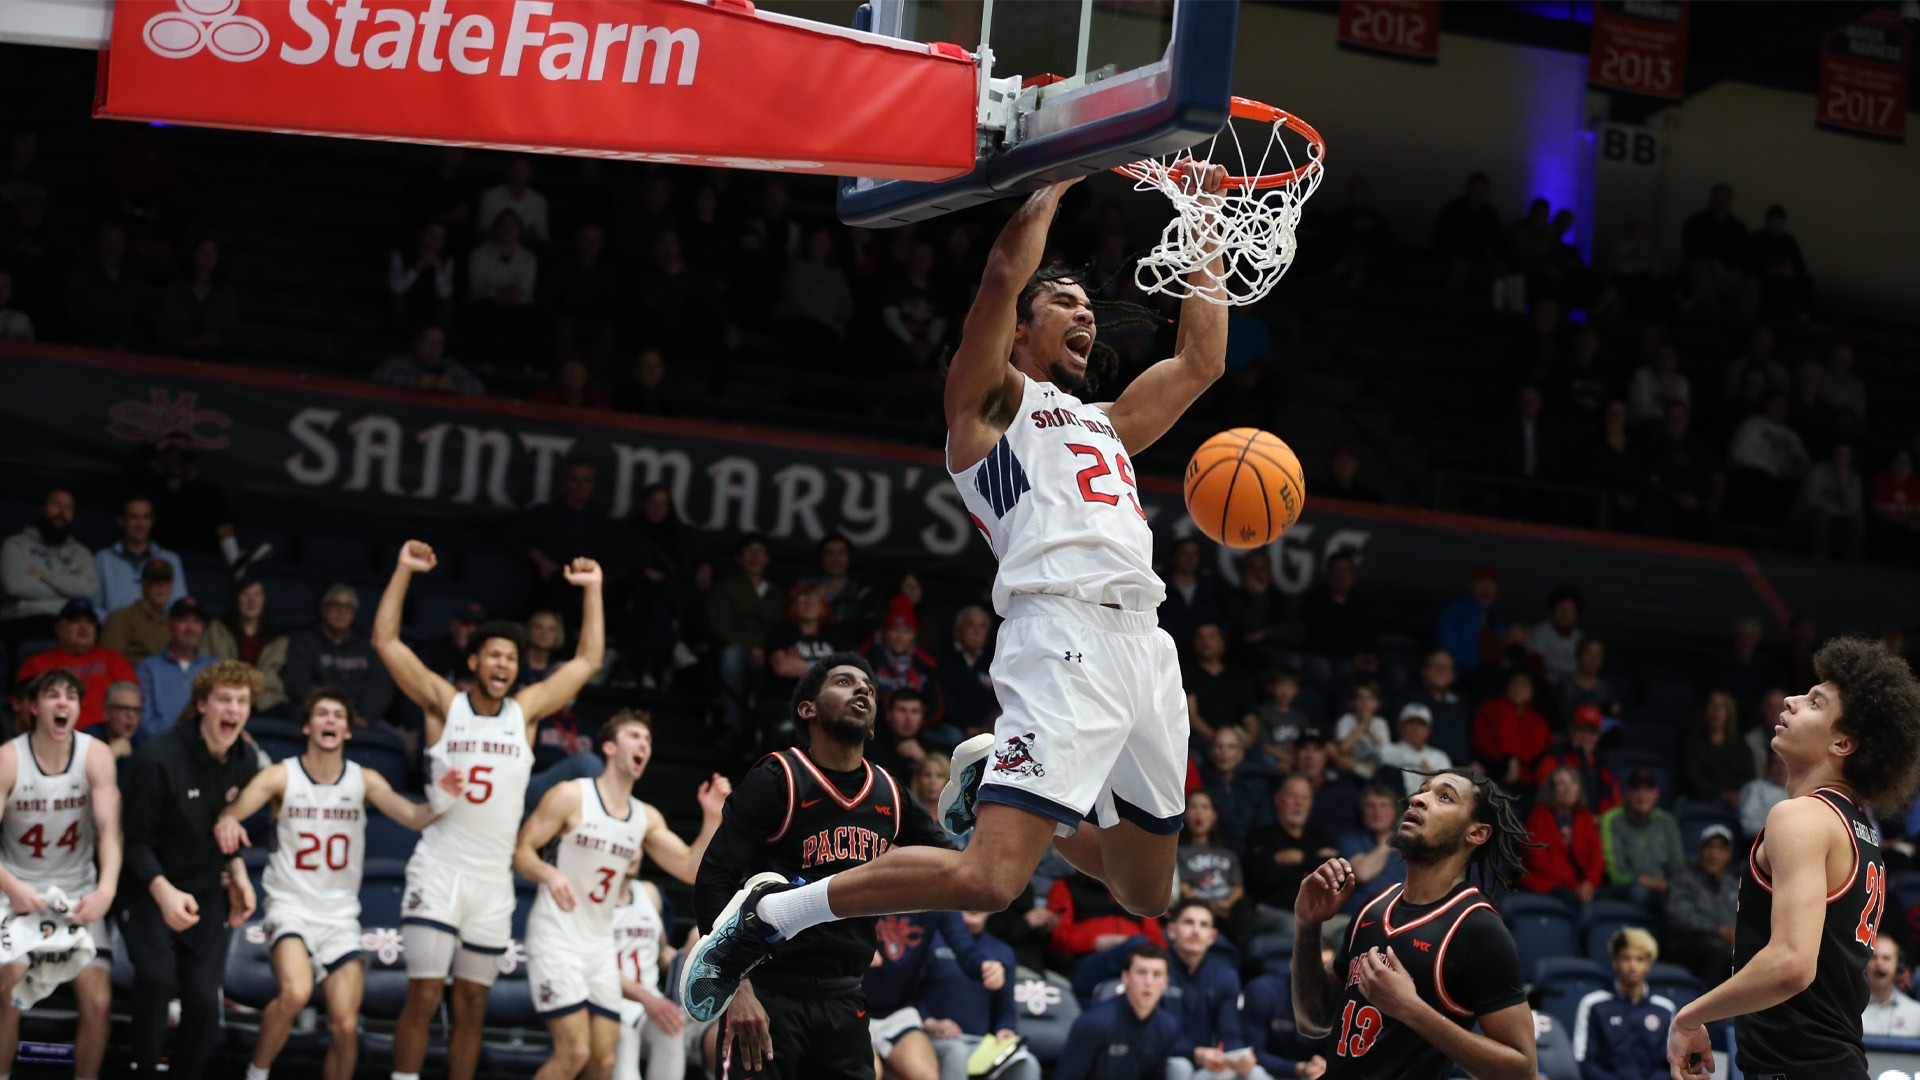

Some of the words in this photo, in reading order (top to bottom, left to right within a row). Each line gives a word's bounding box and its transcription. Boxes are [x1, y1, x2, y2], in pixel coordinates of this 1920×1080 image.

[1351, 4, 1427, 48] 2012
[1600, 45, 1674, 90] 2013
[1826, 85, 1897, 128] 2017
[1605, 128, 1656, 165] BB
[1030, 407, 1083, 430] SAINT
[285, 406, 577, 510] SAINT
[606, 442, 971, 556] MARY'S
[465, 765, 494, 804] 5
[18, 820, 82, 859] 44
[295, 832, 349, 871] 20
[588, 866, 617, 904] 3
[1855, 860, 1887, 950] 21
[1337, 999, 1383, 1058] 13
